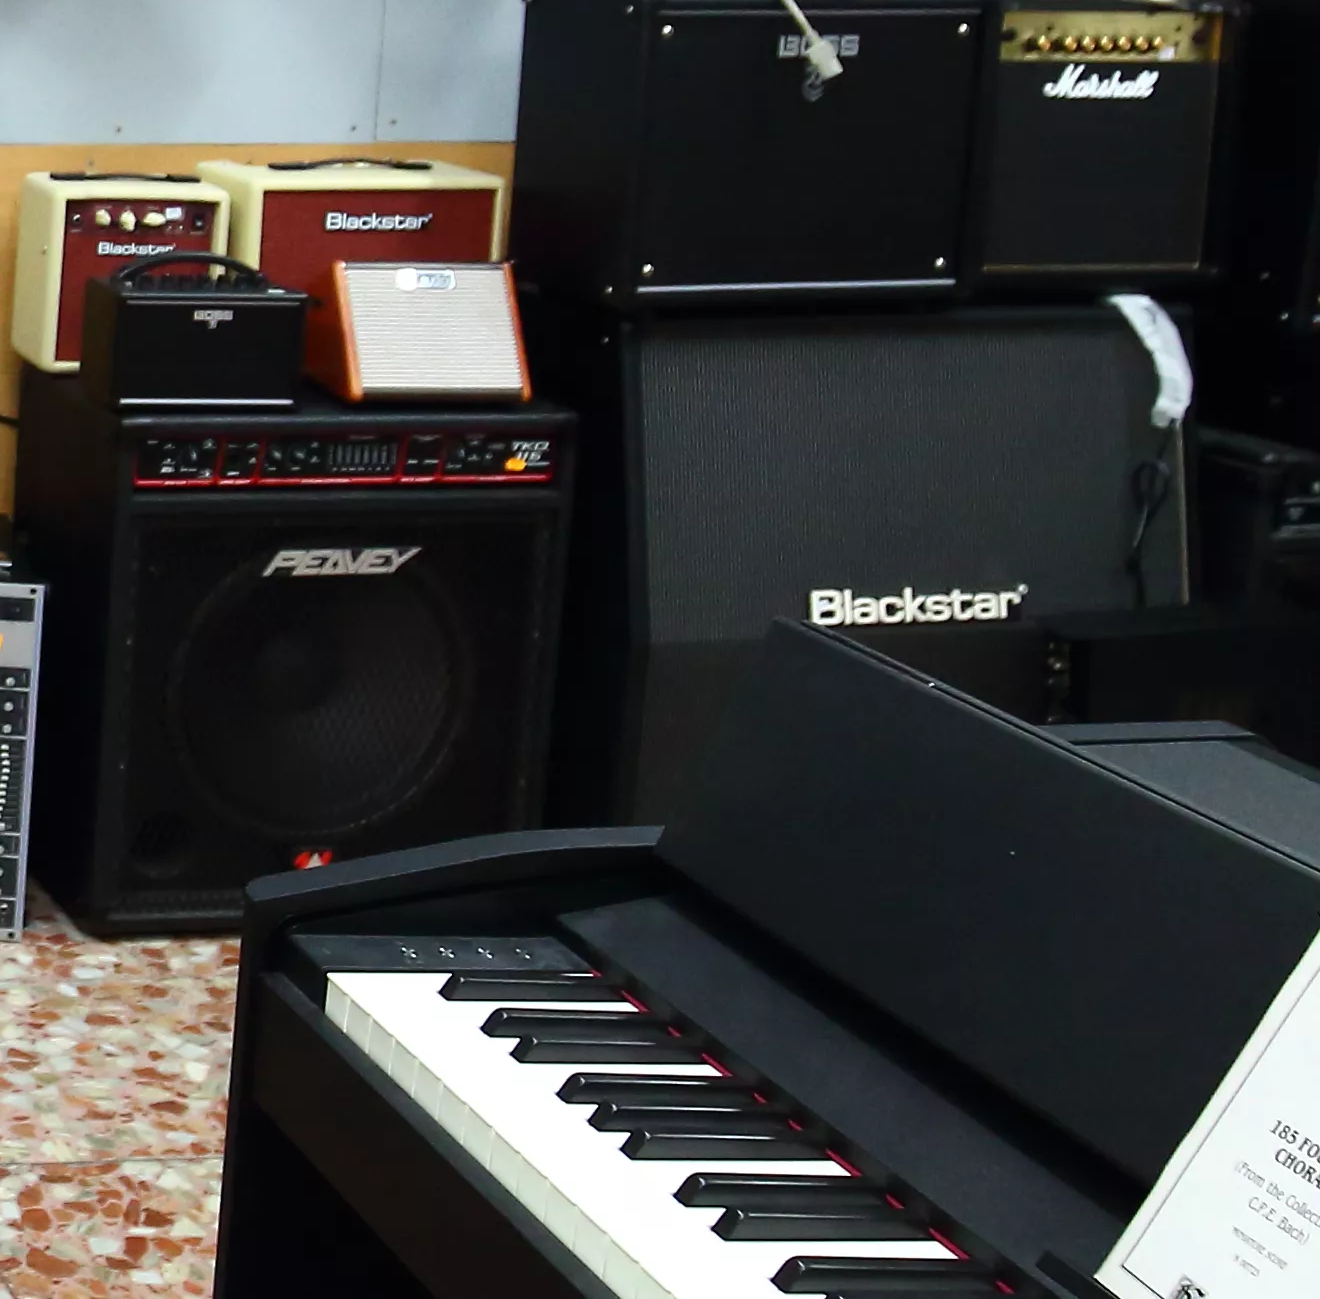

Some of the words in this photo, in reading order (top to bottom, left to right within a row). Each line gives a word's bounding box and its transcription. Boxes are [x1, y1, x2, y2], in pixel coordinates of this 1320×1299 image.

[1043, 63, 1158, 99] Marshall
[325, 211, 432, 231] Blackstar
[97, 241, 175, 256] Blackstar
[262, 547, 422, 577] PEAVEY
[810, 587, 1022, 626] Blackstar
[1269, 1119, 1300, 1145] 185
